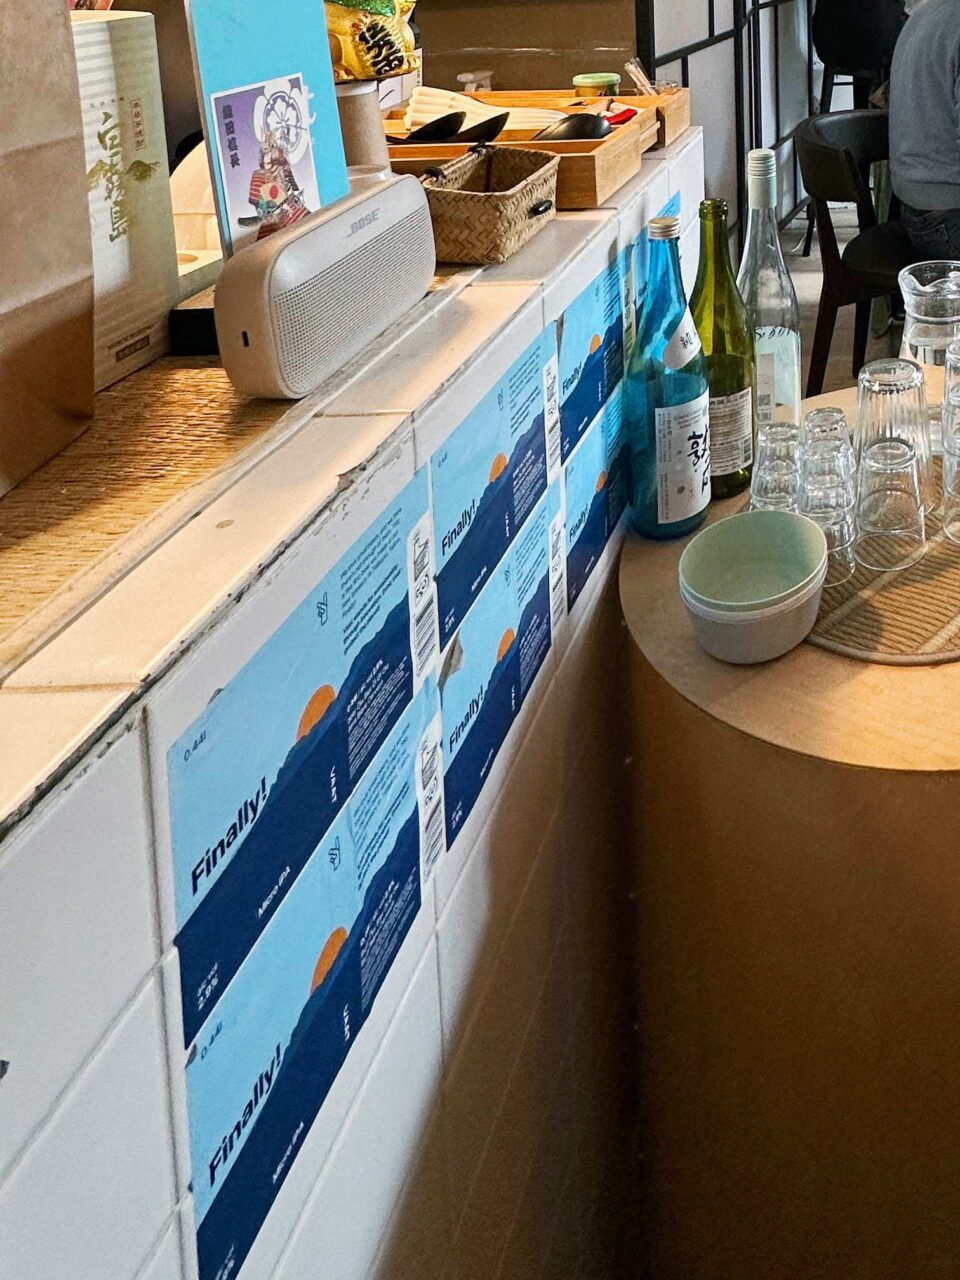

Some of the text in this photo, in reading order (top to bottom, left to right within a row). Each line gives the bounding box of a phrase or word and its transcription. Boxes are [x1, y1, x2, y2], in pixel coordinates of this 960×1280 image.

[348, 208, 381, 236] BOSE
[441, 499, 477, 556] Finally!
[449, 685, 485, 753] Finally!
[191, 776, 267, 897] Finally!
[208, 1042, 282, 1188] Finally!
